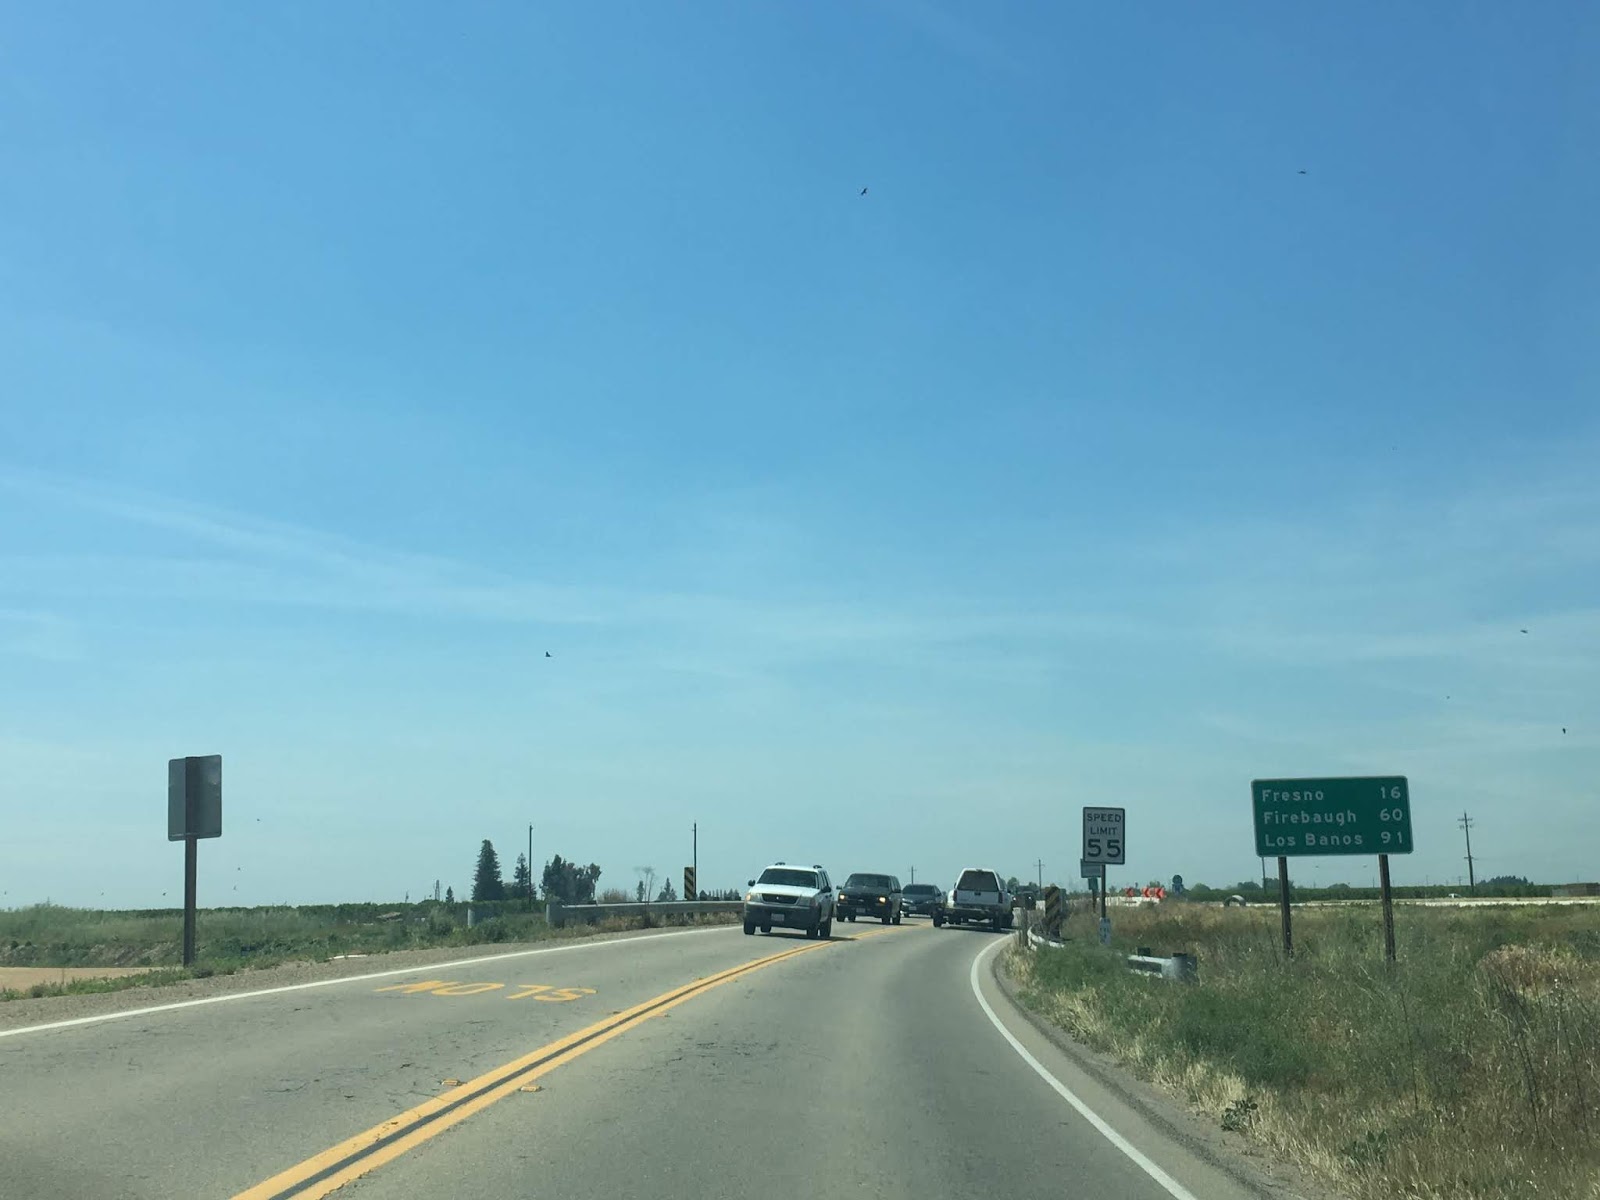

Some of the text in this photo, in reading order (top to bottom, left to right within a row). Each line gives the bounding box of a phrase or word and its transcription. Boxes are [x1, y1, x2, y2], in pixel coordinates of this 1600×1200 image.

[1261, 785, 1401, 803] Fresno 16
[1087, 813, 1122, 823] SPEED
[1263, 807, 1404, 827] Firebaugh 60
[1090, 826, 1117, 835] LIMIT
[1265, 830, 1403, 847] Los Banos 91
[1087, 838, 1121, 858] 55
